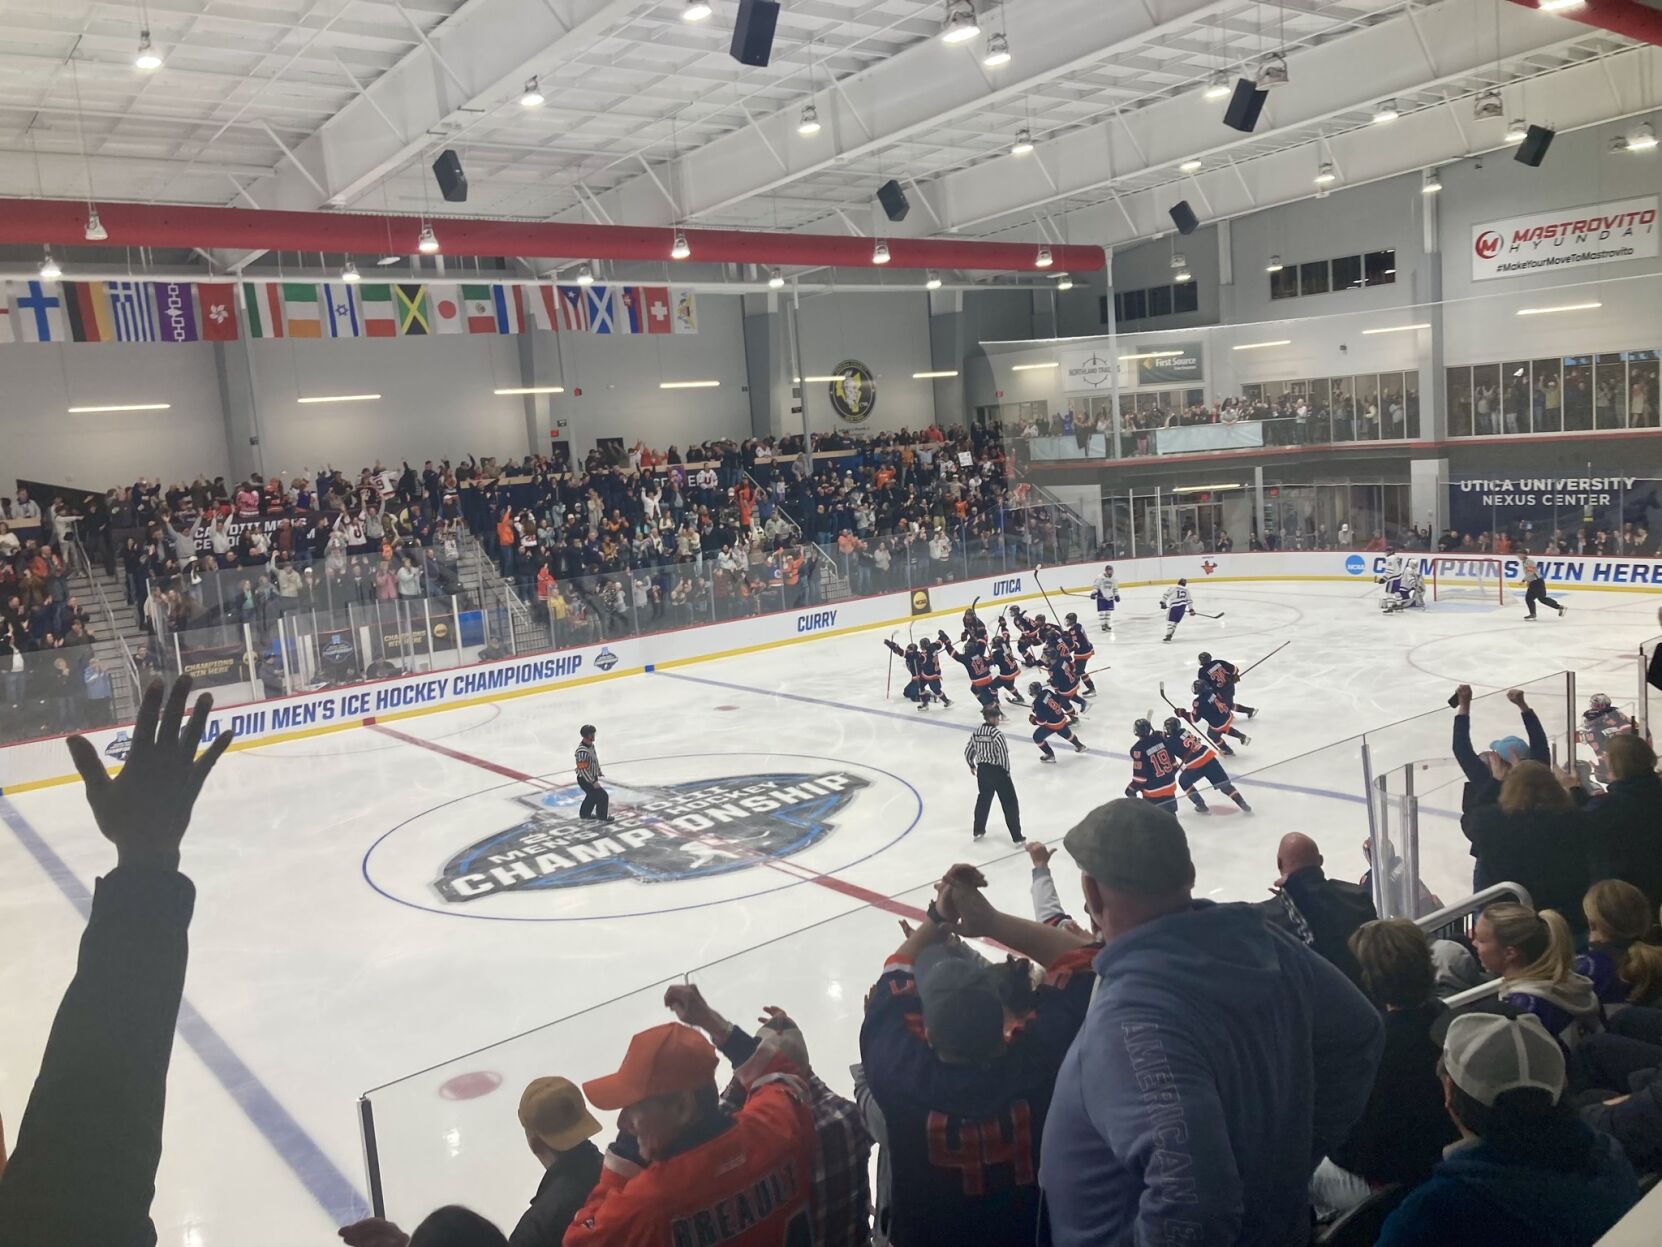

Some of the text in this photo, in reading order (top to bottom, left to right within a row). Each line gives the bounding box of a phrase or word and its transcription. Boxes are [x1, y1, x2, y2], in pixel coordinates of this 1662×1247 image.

[1509, 223, 1654, 253] HYUNDAI
[1511, 209, 1656, 243] MASTROVITO
[1496, 246, 1635, 272] #MakeYourMoveToMastrovito
[1155, 357, 1197, 367] First Source
[1460, 477, 1636, 492] UTICA UNIVERSITY
[1482, 494, 1610, 506] NEXUS CENTER
[1372, 556, 1520, 578] CMPIONS
[1592, 563, 1662, 584] HERE
[993, 578, 1022, 596] UTICA
[797, 609, 837, 632] CURRY
[231, 712, 265, 738] DIII
[271, 700, 336, 731] MEN'S
[340, 692, 371, 717] ICE
[376, 678, 449, 711] HOCKEY
[453, 654, 583, 696] CHAMPIONSHIP
[1150, 748, 1174, 778] 19
[663, 780, 779, 815] HOCKEY
[450, 772, 851, 896] CHAMPIONSHIP
[1121, 1021, 1199, 1205] AMERICAN
[927, 1098, 1034, 1196] 44
